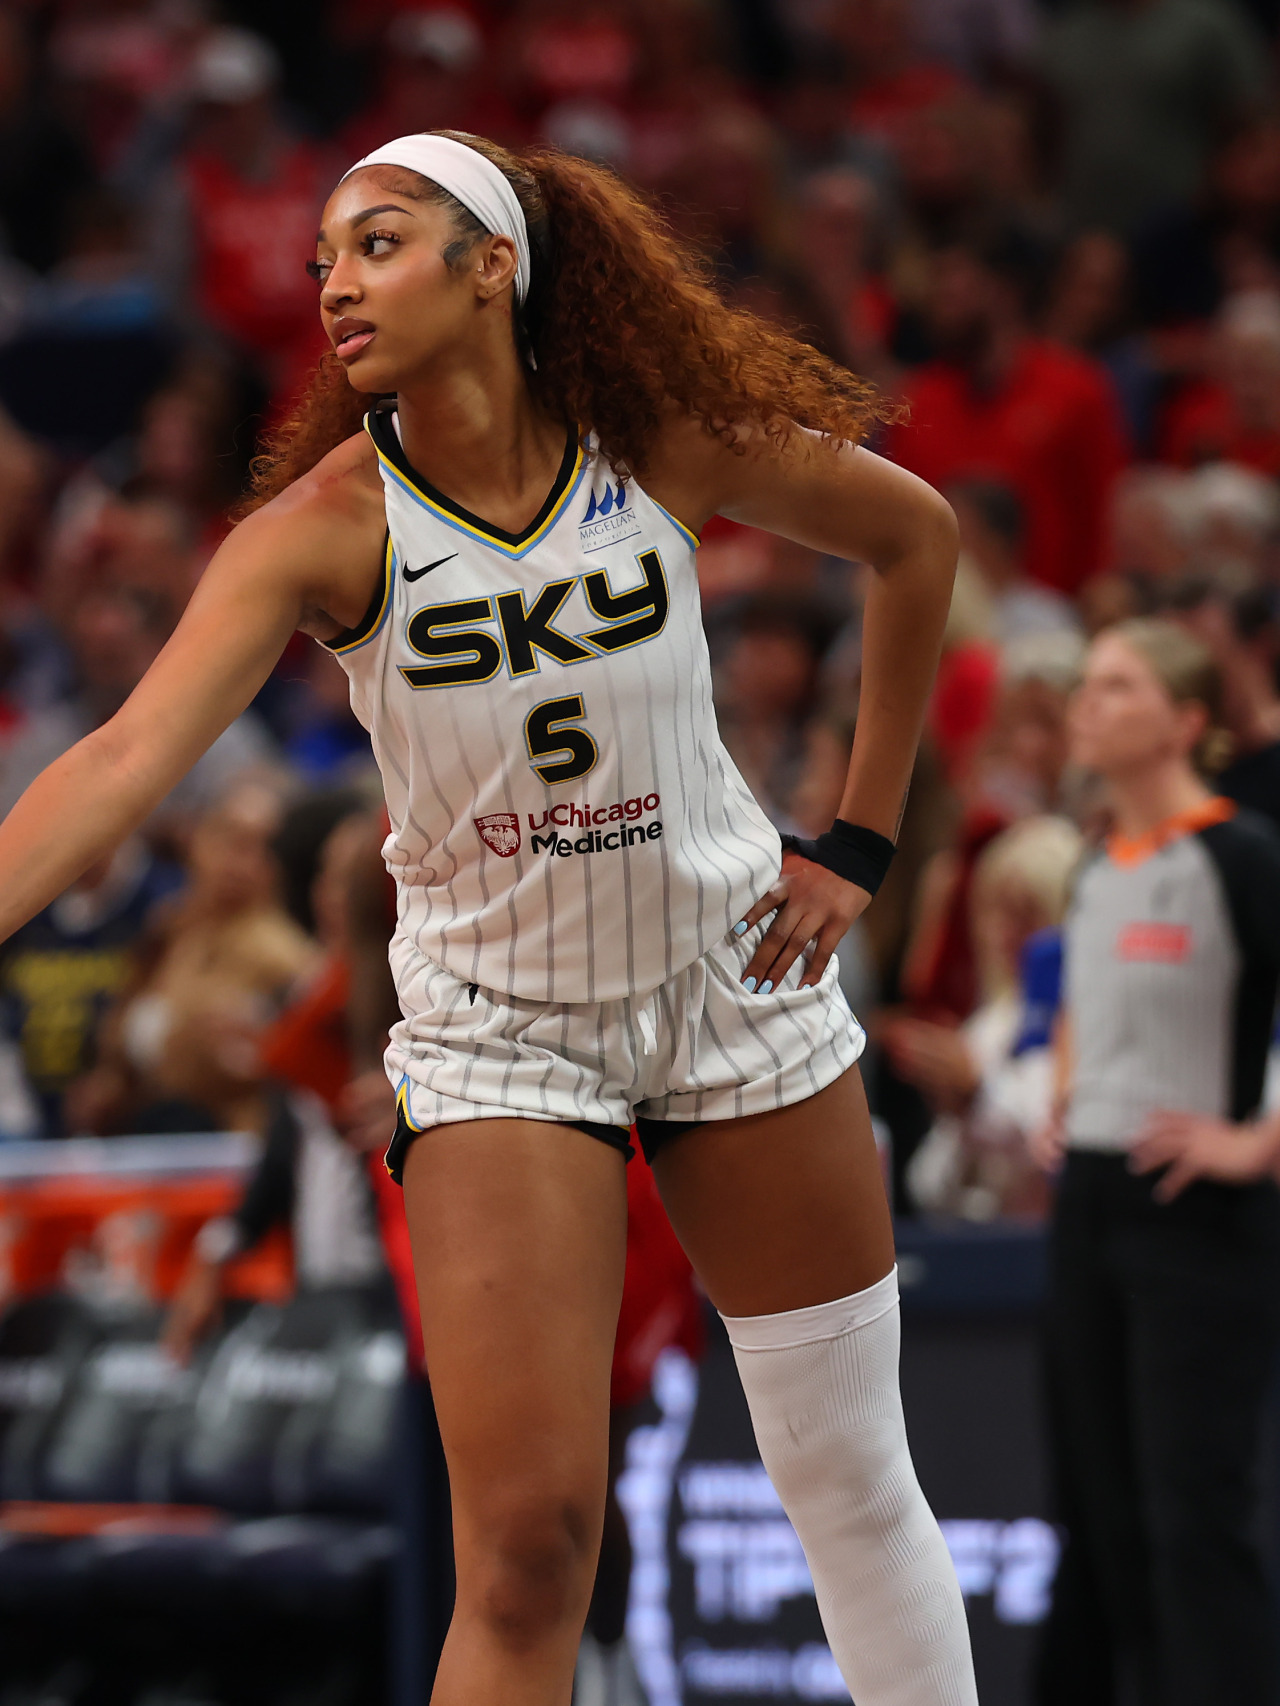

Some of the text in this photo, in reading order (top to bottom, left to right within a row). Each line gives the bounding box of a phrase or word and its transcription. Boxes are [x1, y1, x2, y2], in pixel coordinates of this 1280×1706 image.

[579, 510, 637, 541] MAGELLAN
[396, 546, 670, 691] SKY
[523, 692, 600, 786] 5
[531, 820, 663, 858] Medicine
